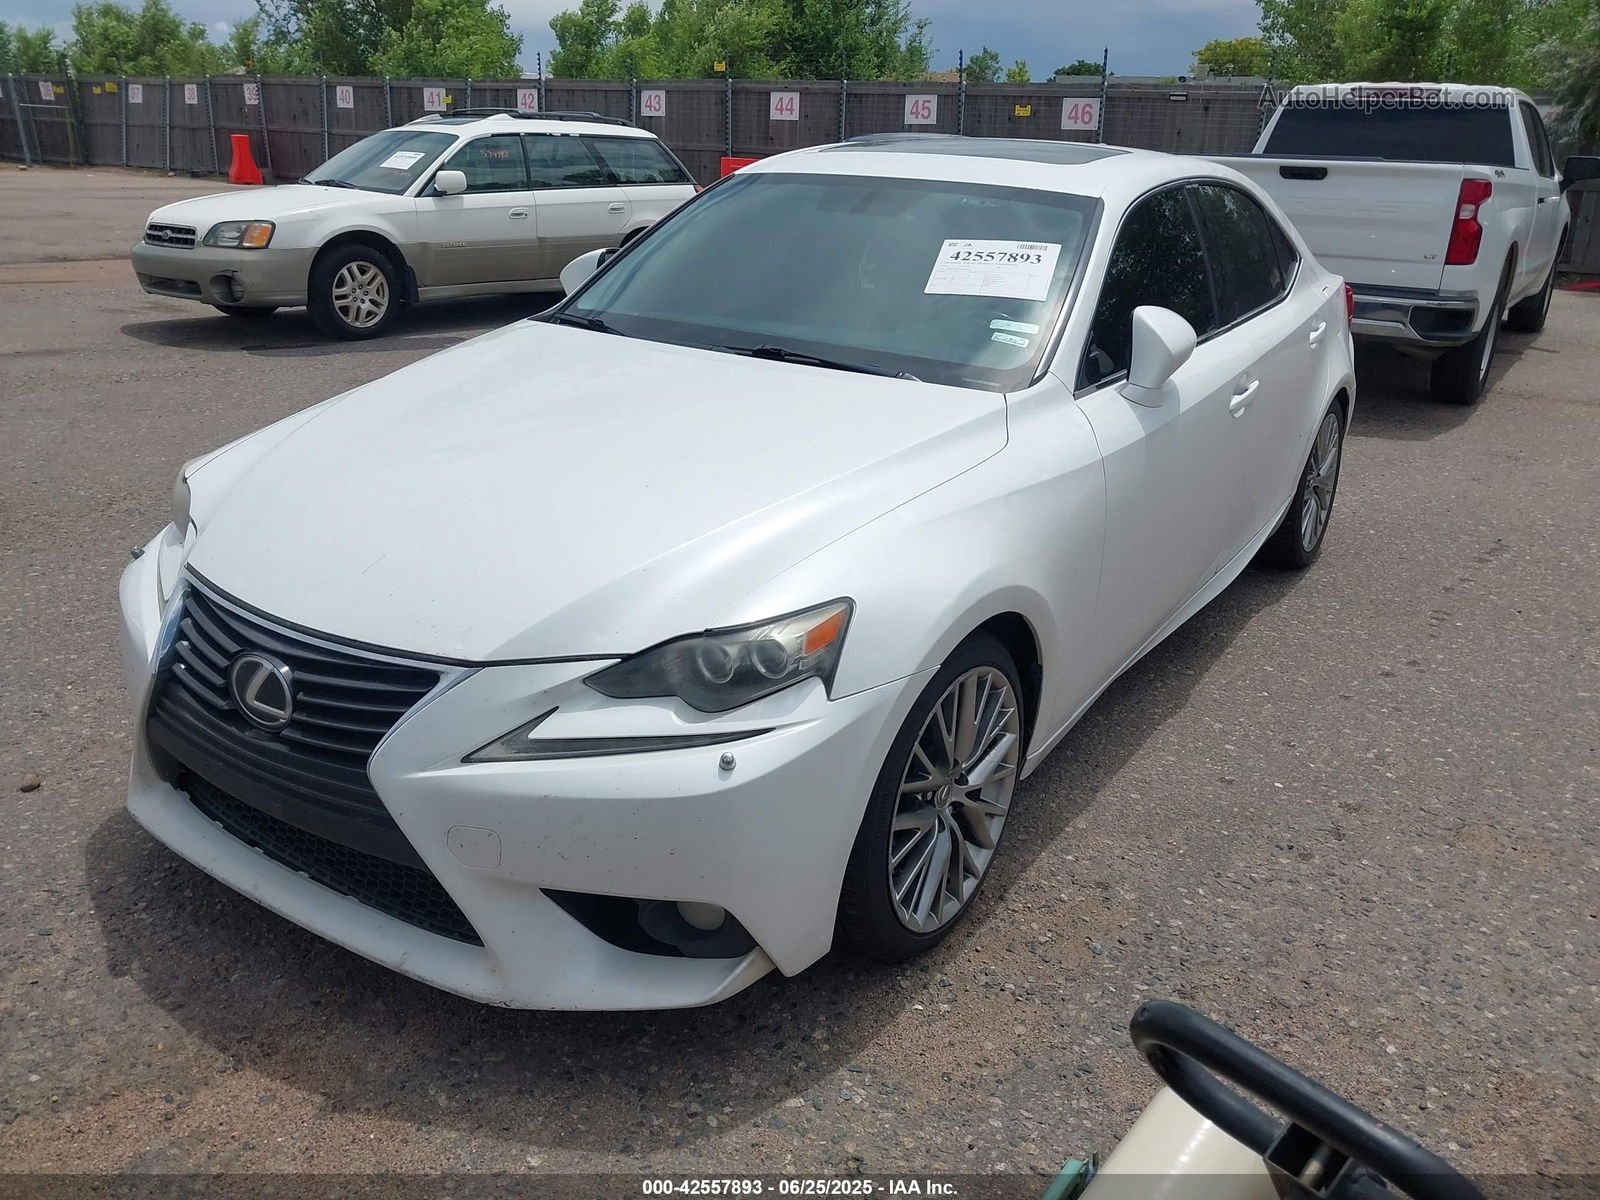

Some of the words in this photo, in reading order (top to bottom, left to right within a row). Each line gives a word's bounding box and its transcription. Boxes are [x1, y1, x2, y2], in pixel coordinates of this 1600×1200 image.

[339, 89, 351, 104] 40
[428, 91, 441, 107] 41
[521, 92, 534, 109] 42
[645, 94, 661, 112] 43
[775, 96, 795, 115] 44
[910, 100, 931, 120] 45
[1068, 103, 1093, 125] 46
[950, 250, 1042, 264] 42557893
